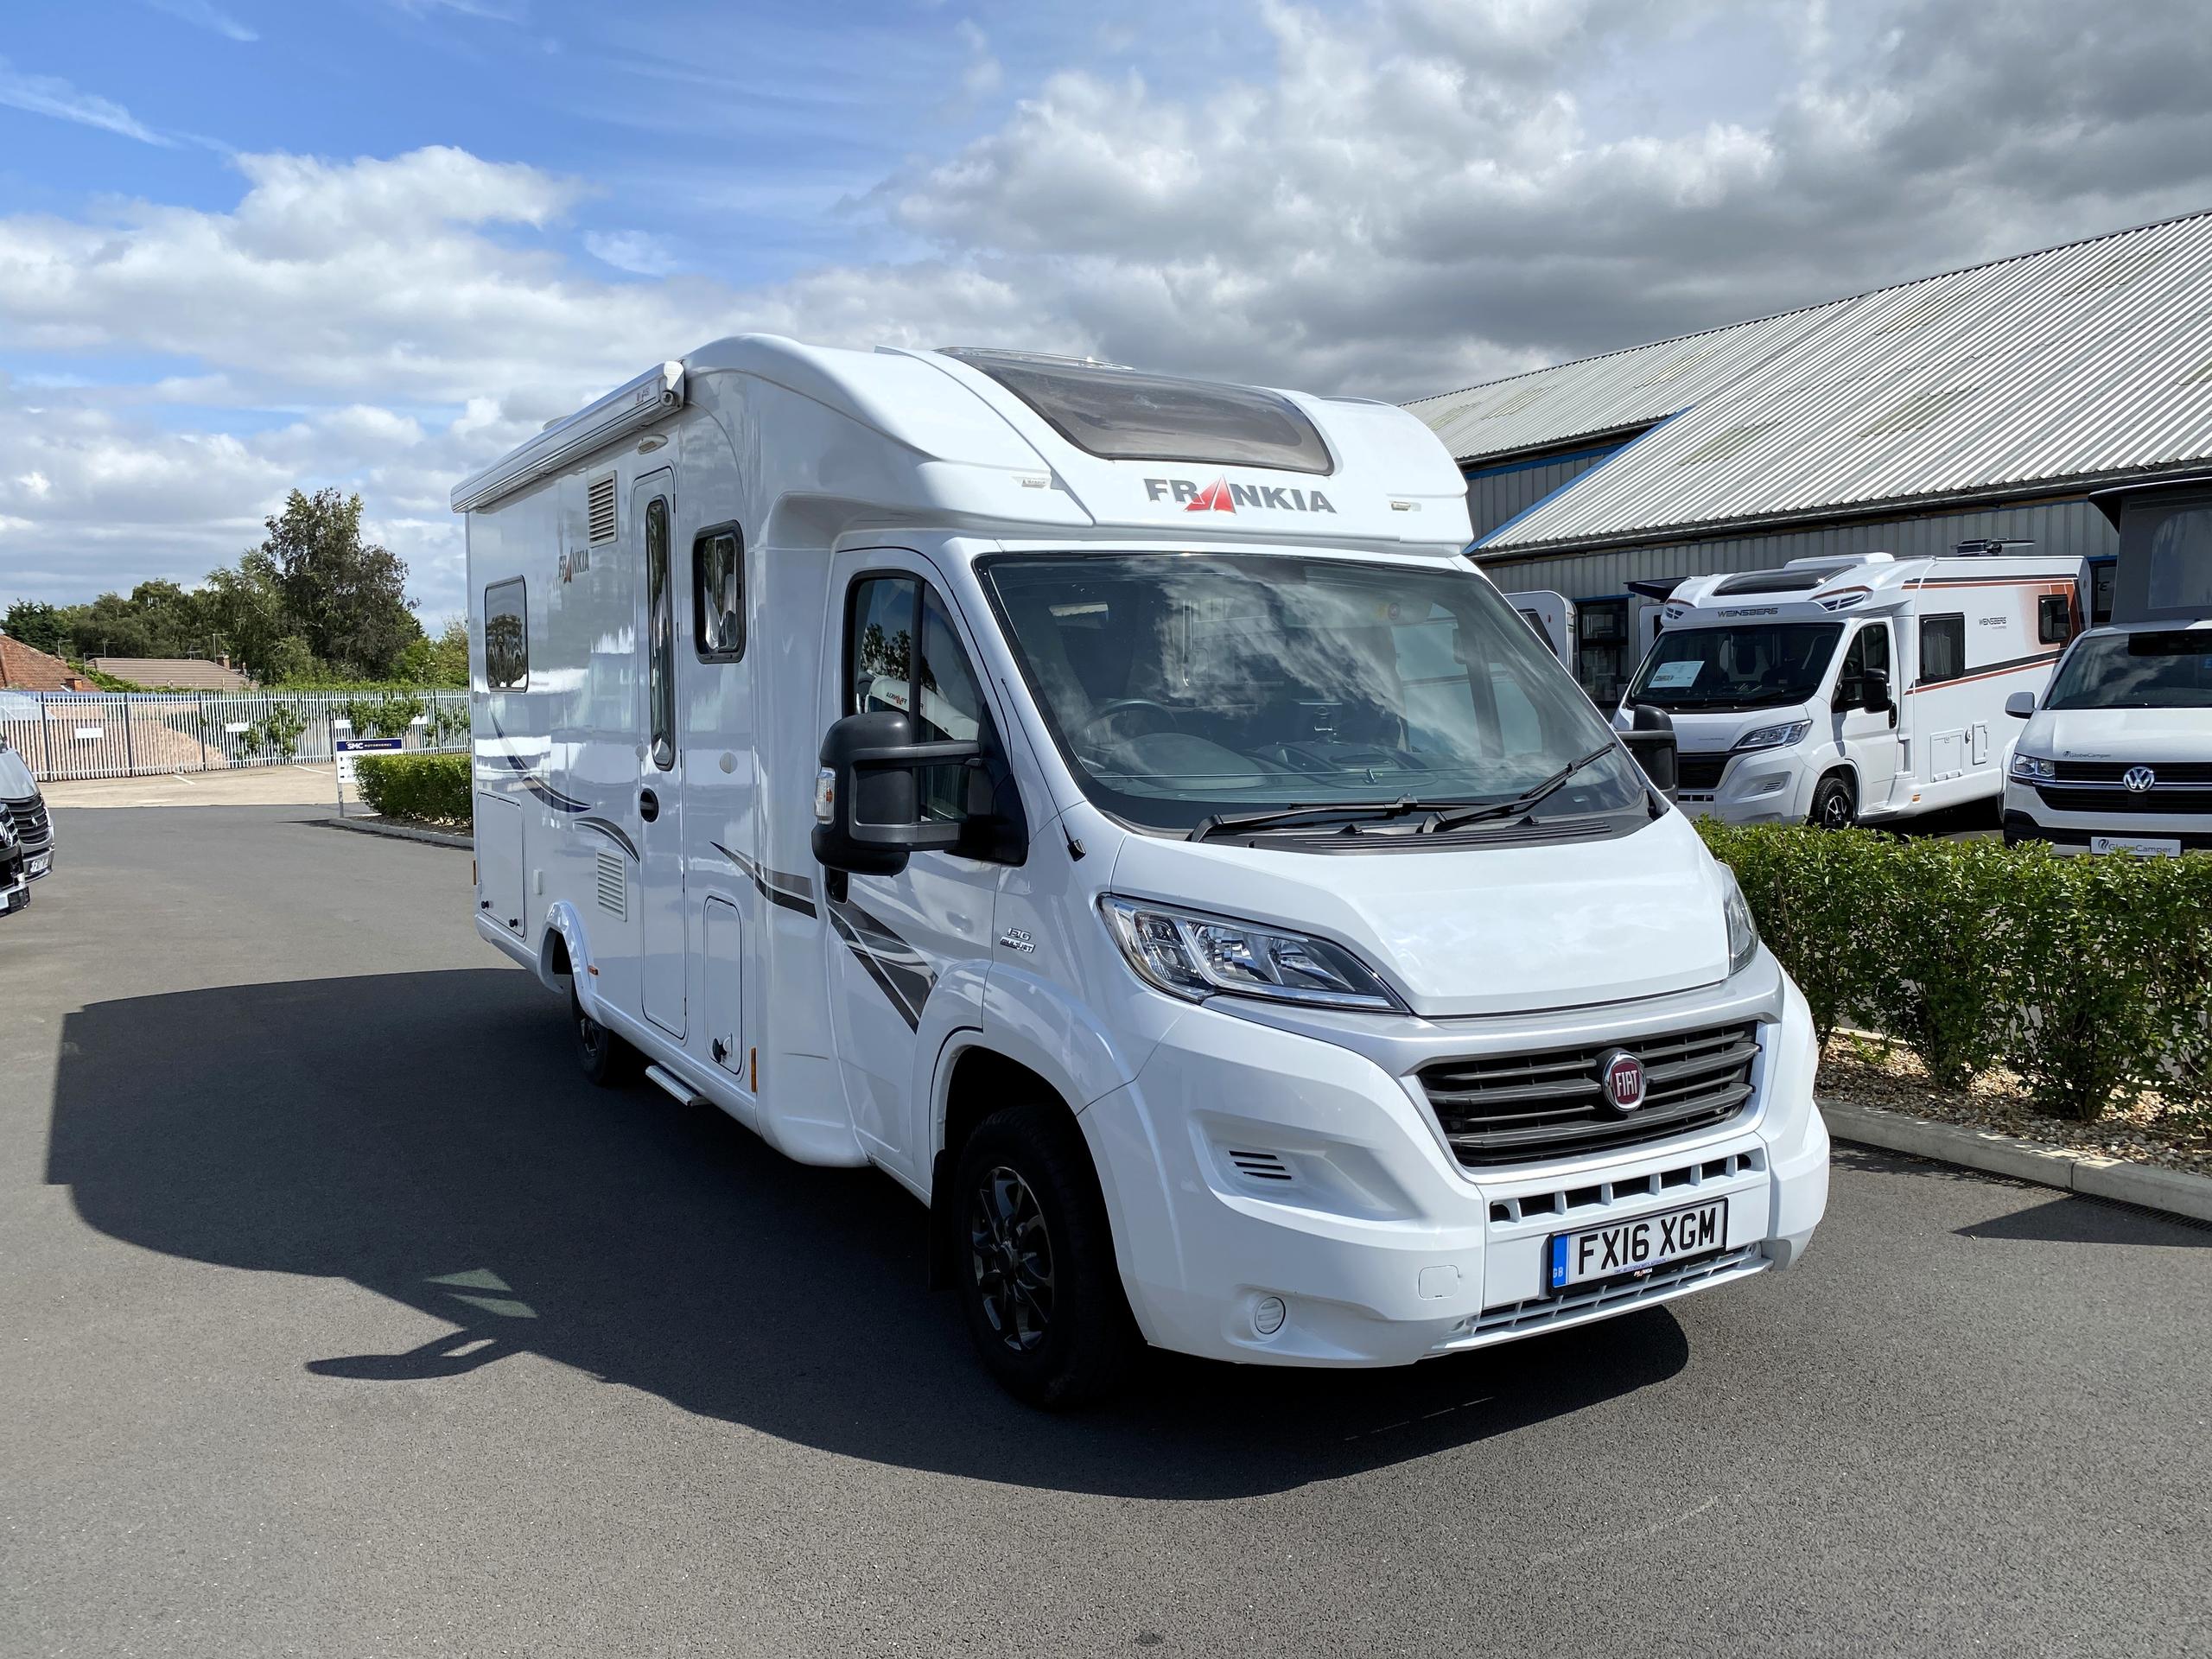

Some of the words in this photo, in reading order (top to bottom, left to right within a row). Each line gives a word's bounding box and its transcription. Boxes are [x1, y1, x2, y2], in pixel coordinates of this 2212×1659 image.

[1143, 474, 1338, 514] FRANKIA
[558, 546, 589, 584] FRANKIA
[1717, 607, 1779, 618] WEINSBERG
[1615, 1070, 1637, 1097] FIAT
[1579, 1224, 1650, 1275] FX16
[1659, 1207, 1717, 1256] XGM
[1553, 1266, 1564, 1279] GB
